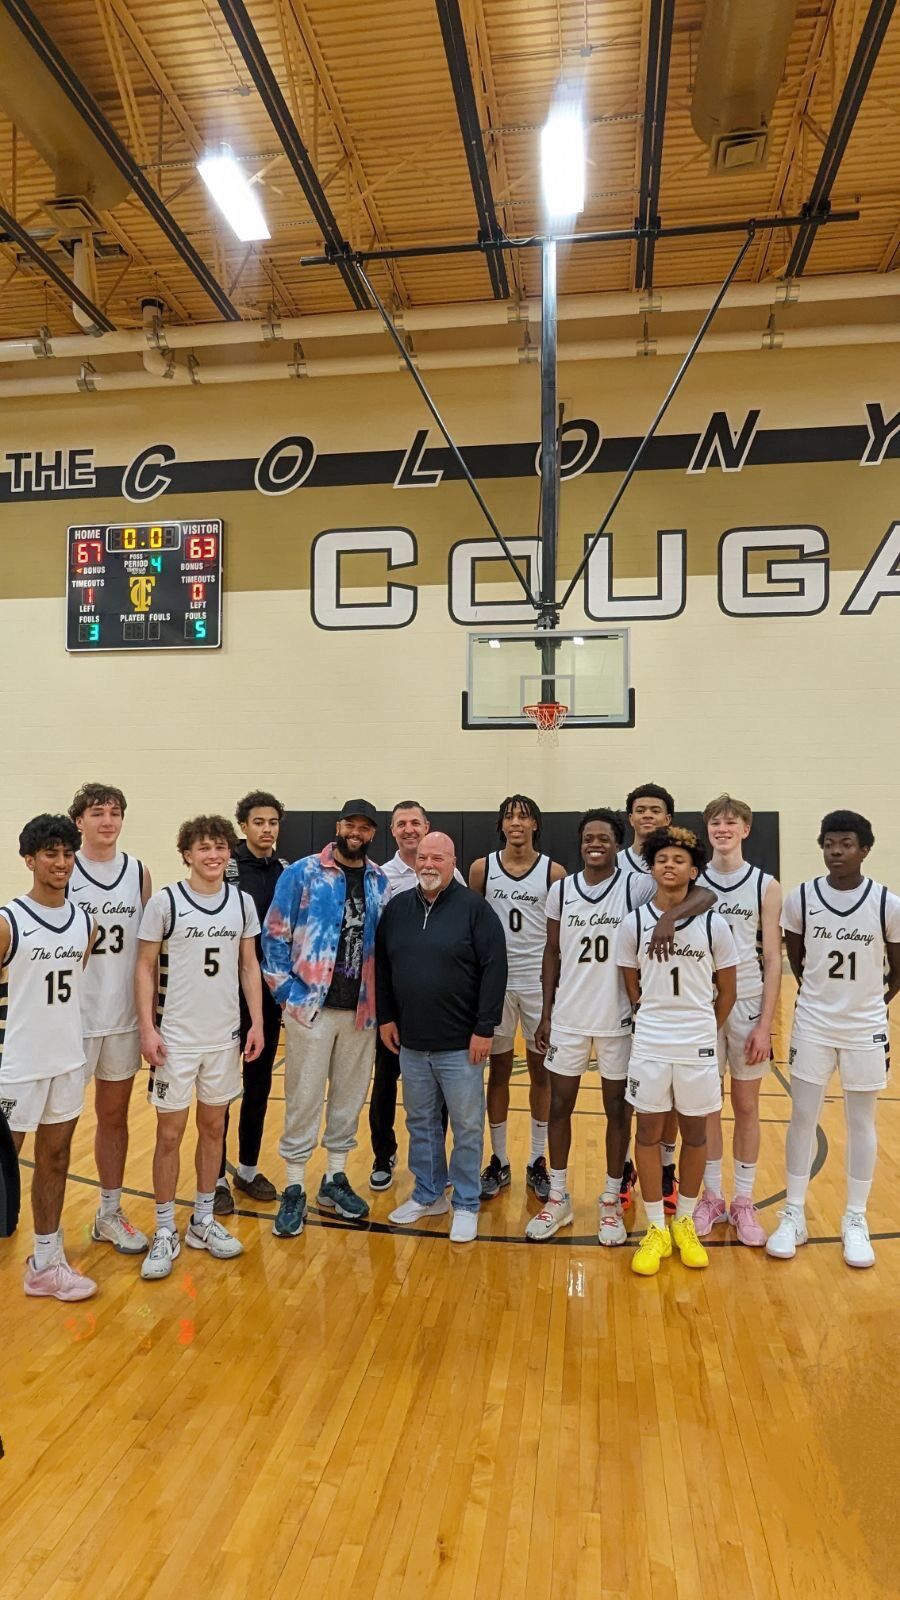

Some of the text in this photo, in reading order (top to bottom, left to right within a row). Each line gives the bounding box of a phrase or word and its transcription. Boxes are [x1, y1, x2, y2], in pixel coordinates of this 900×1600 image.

[6, 449, 96, 493] THE
[74, 530, 101, 540] HOME
[182, 524, 219, 535] VISITOR
[77, 543, 101, 563] 67
[190, 538, 215, 559] 63
[83, 566, 106, 574] BONUS
[124, 560, 149, 568] PERIOD
[151, 556, 162, 573] 4
[180, 562, 204, 571] BONUS
[72, 579, 105, 588] TIMEOUTS
[181, 575, 216, 584] TIMEOUTS
[87, 588, 93, 604] 1
[192, 584, 203, 600] 0
[79, 605, 95, 613] LEFT
[190, 601, 207, 609] LEFT
[79, 615, 100, 623] FOULS
[120, 613, 171, 622] PLAYER FOULS
[185, 612, 207, 620] FOULS
[89, 624, 99, 641] 3
[195, 621, 206, 638] 5
[493, 889, 539, 905] The Colony
[78, 901, 136, 918] The Colony
[718, 902, 753, 920] Colony
[509, 908, 522, 932] 0
[567, 913, 622, 928] The Colony
[91, 924, 124, 954] 23
[184, 925, 237, 940] The Colony
[812, 926, 874, 945] The Colony
[30, 945, 83, 963] The Colony
[578, 935, 609, 964] 20
[671, 942, 706, 962] Colony
[203, 947, 220, 977] 5
[828, 950, 857, 981] 21
[44, 969, 73, 1005] 15
[670, 966, 680, 996] 1
